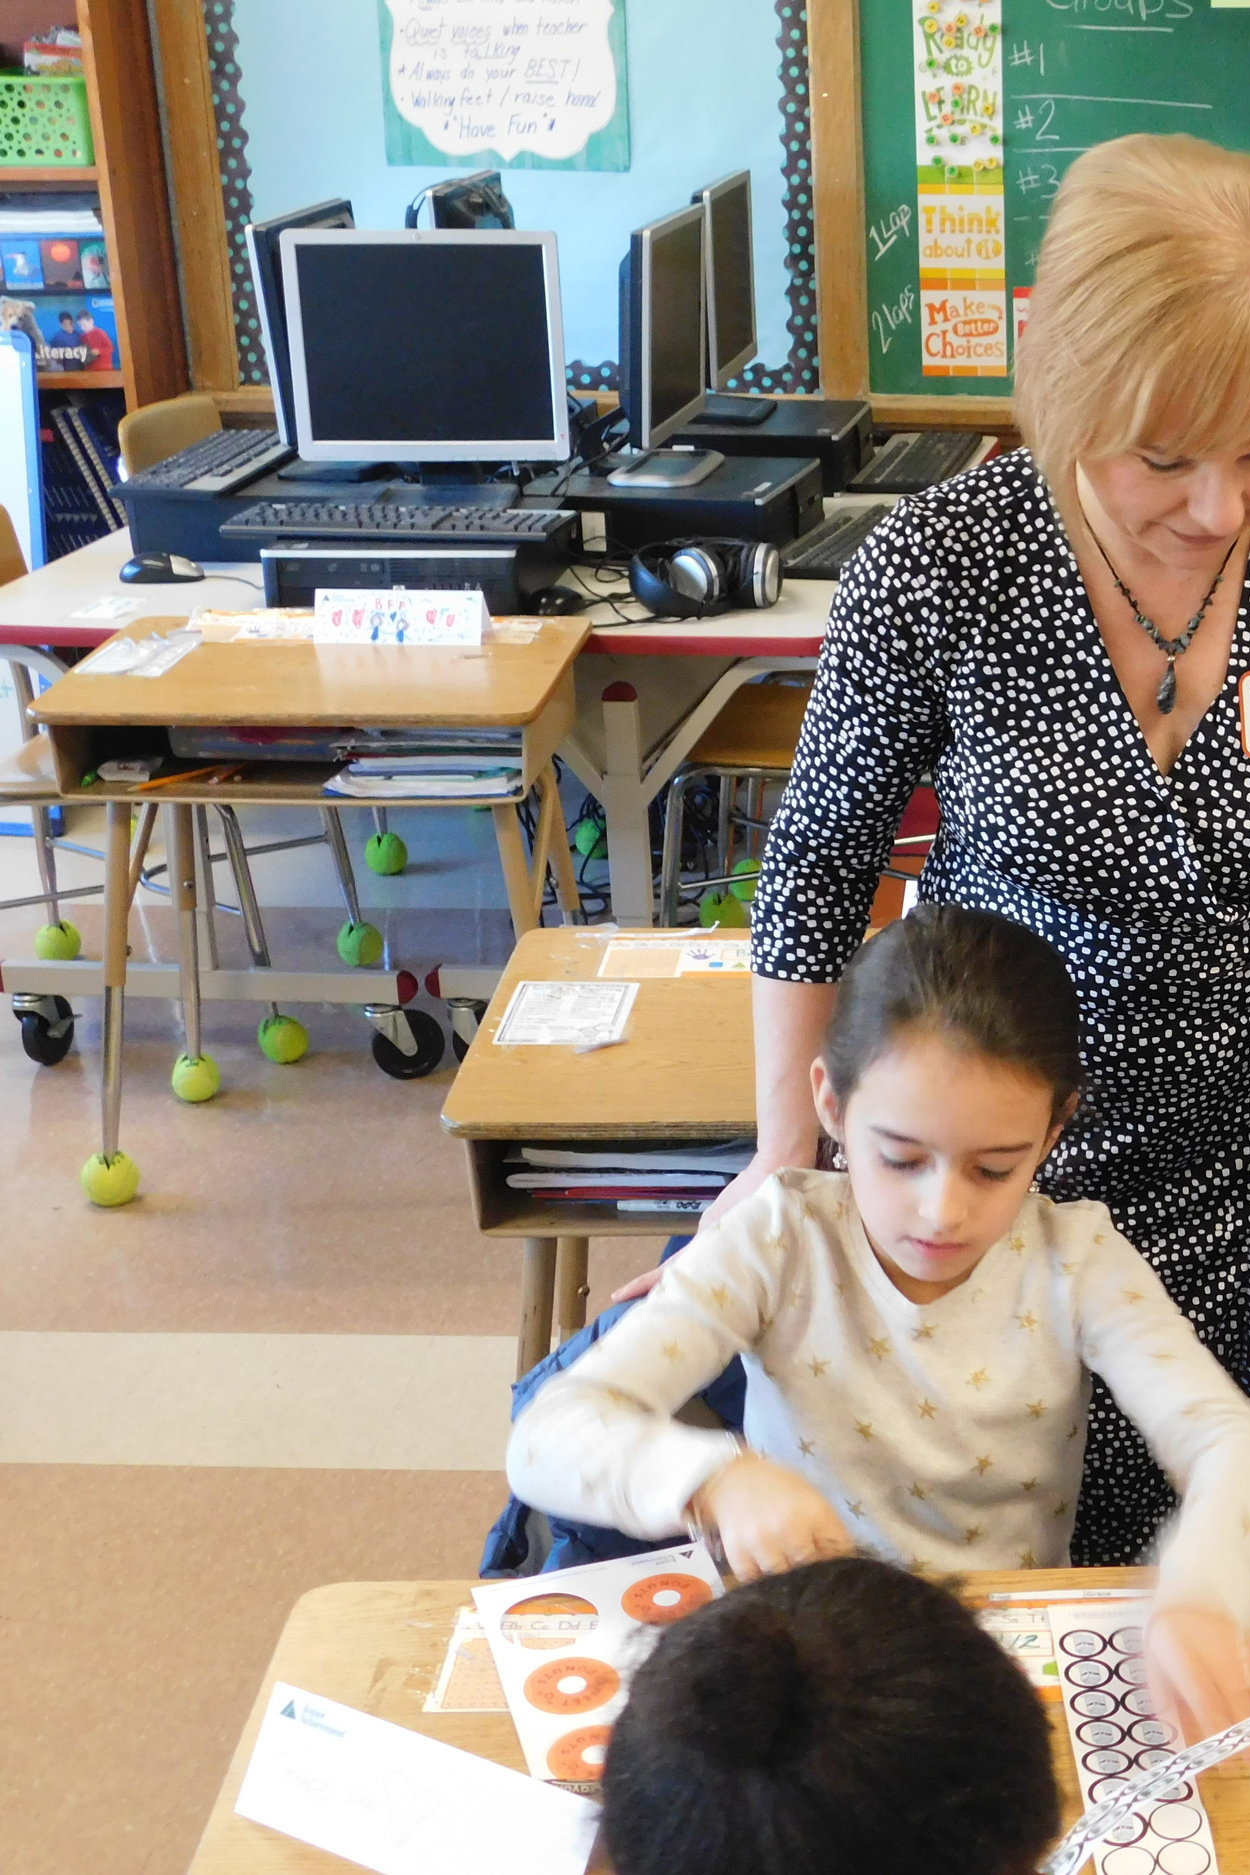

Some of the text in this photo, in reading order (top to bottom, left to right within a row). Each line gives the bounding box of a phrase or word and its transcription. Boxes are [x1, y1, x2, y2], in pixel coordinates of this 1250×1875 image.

[453, 24, 491, 39] voices
[536, 16, 588, 37] teacher
[1009, 40, 1046, 76] #1
[461, 63, 475, 80] do
[486, 67, 516, 84] your
[459, 86, 493, 107] feet
[514, 92, 556, 108] raise
[1014, 98, 1061, 141] #2
[922, 205, 1001, 235] Think
[923, 237, 974, 259] about
[925, 298, 986, 326] Make
[925, 330, 1004, 358] Choices
